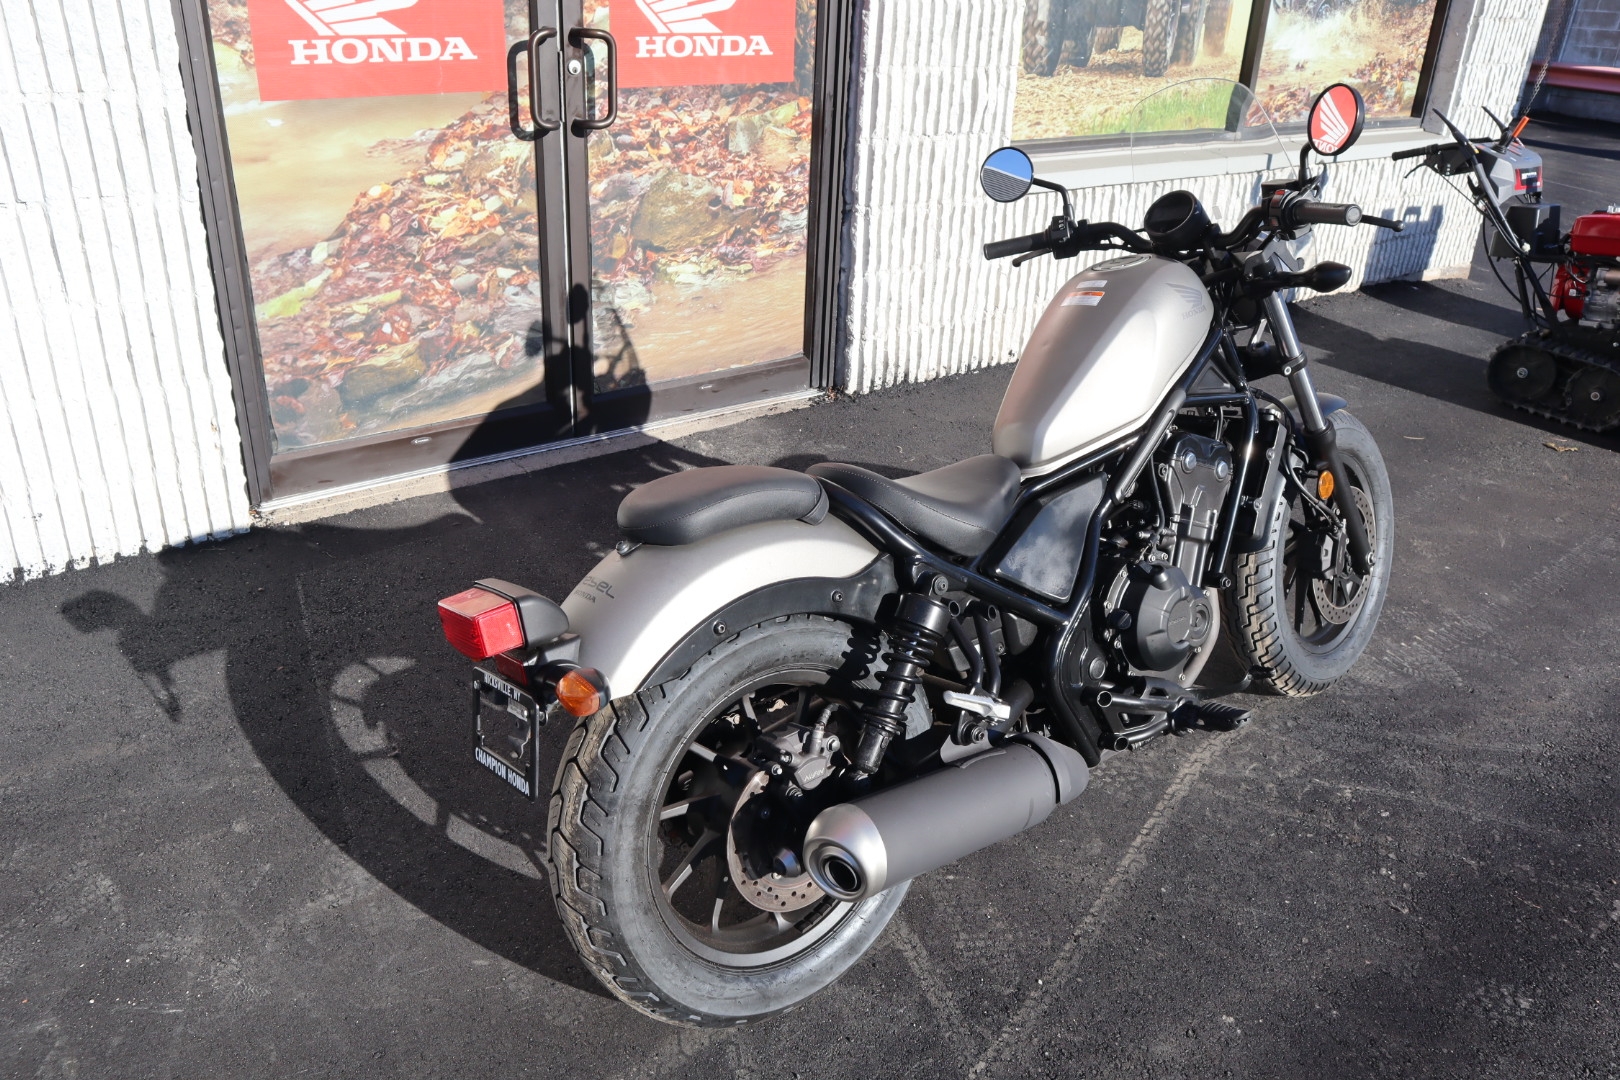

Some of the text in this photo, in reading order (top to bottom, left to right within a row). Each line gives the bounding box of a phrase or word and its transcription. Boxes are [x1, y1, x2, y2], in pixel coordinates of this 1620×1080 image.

[288, 36, 478, 65] HONDA
[635, 35, 774, 58] HONDA
[475, 746, 530, 797] CHAMPION HONDA
